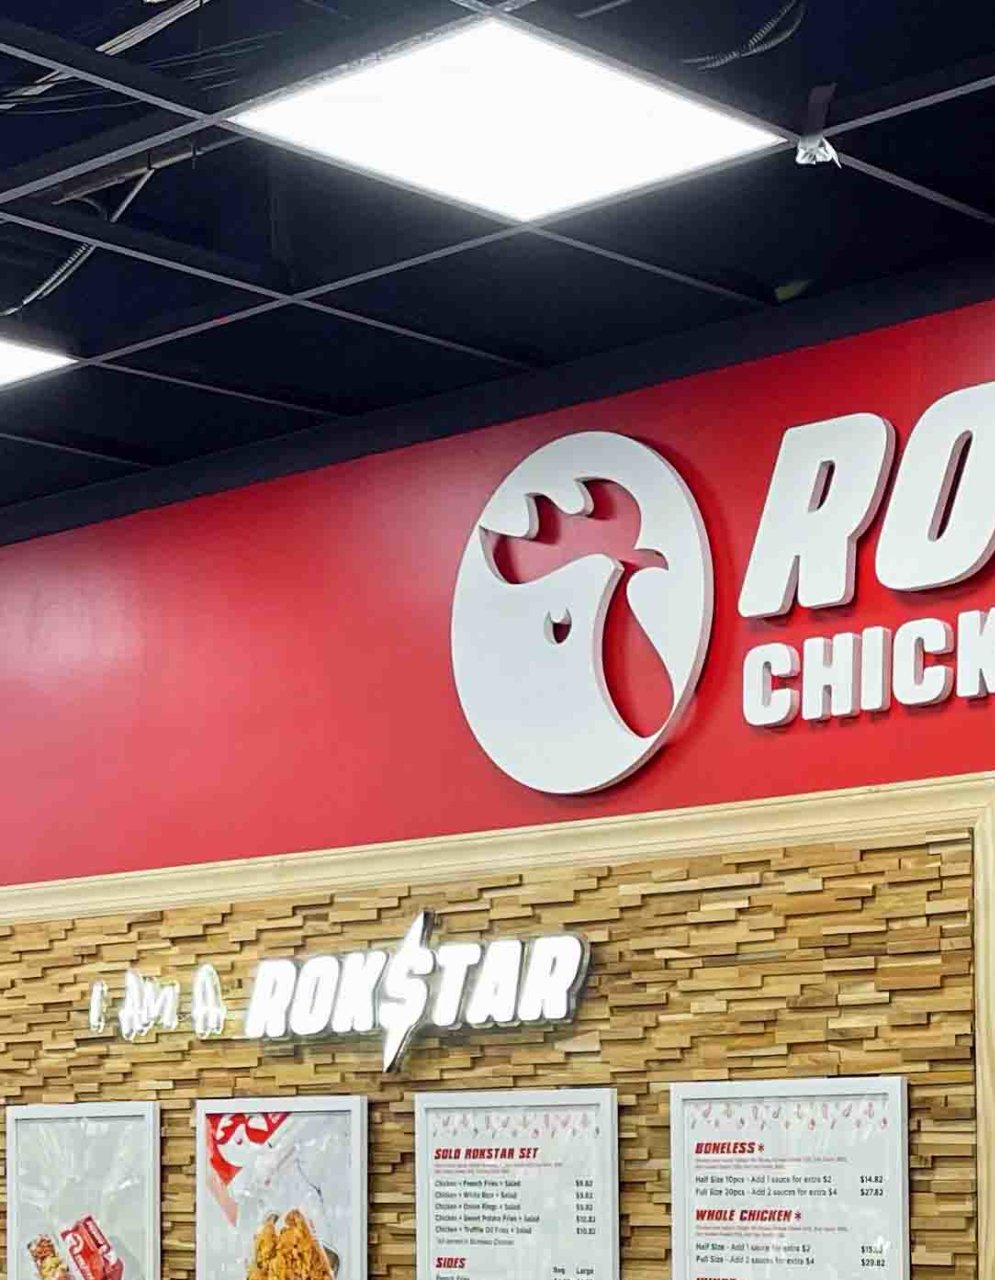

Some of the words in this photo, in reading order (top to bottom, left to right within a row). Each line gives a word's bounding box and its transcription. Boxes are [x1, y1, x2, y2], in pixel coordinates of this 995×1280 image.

[434, 1148, 461, 1160] SOLO
[464, 1148, 515, 1159] ROKSTAR
[518, 1147, 539, 1159] SET
[695, 1142, 756, 1154] BONELESS
[750, 1175, 765, 1183] Add
[823, 1175, 832, 1184] $2
[696, 1209, 736, 1221] WHOLE
[739, 1209, 792, 1222] CHICKEN
[435, 1257, 466, 1269] SIDES
